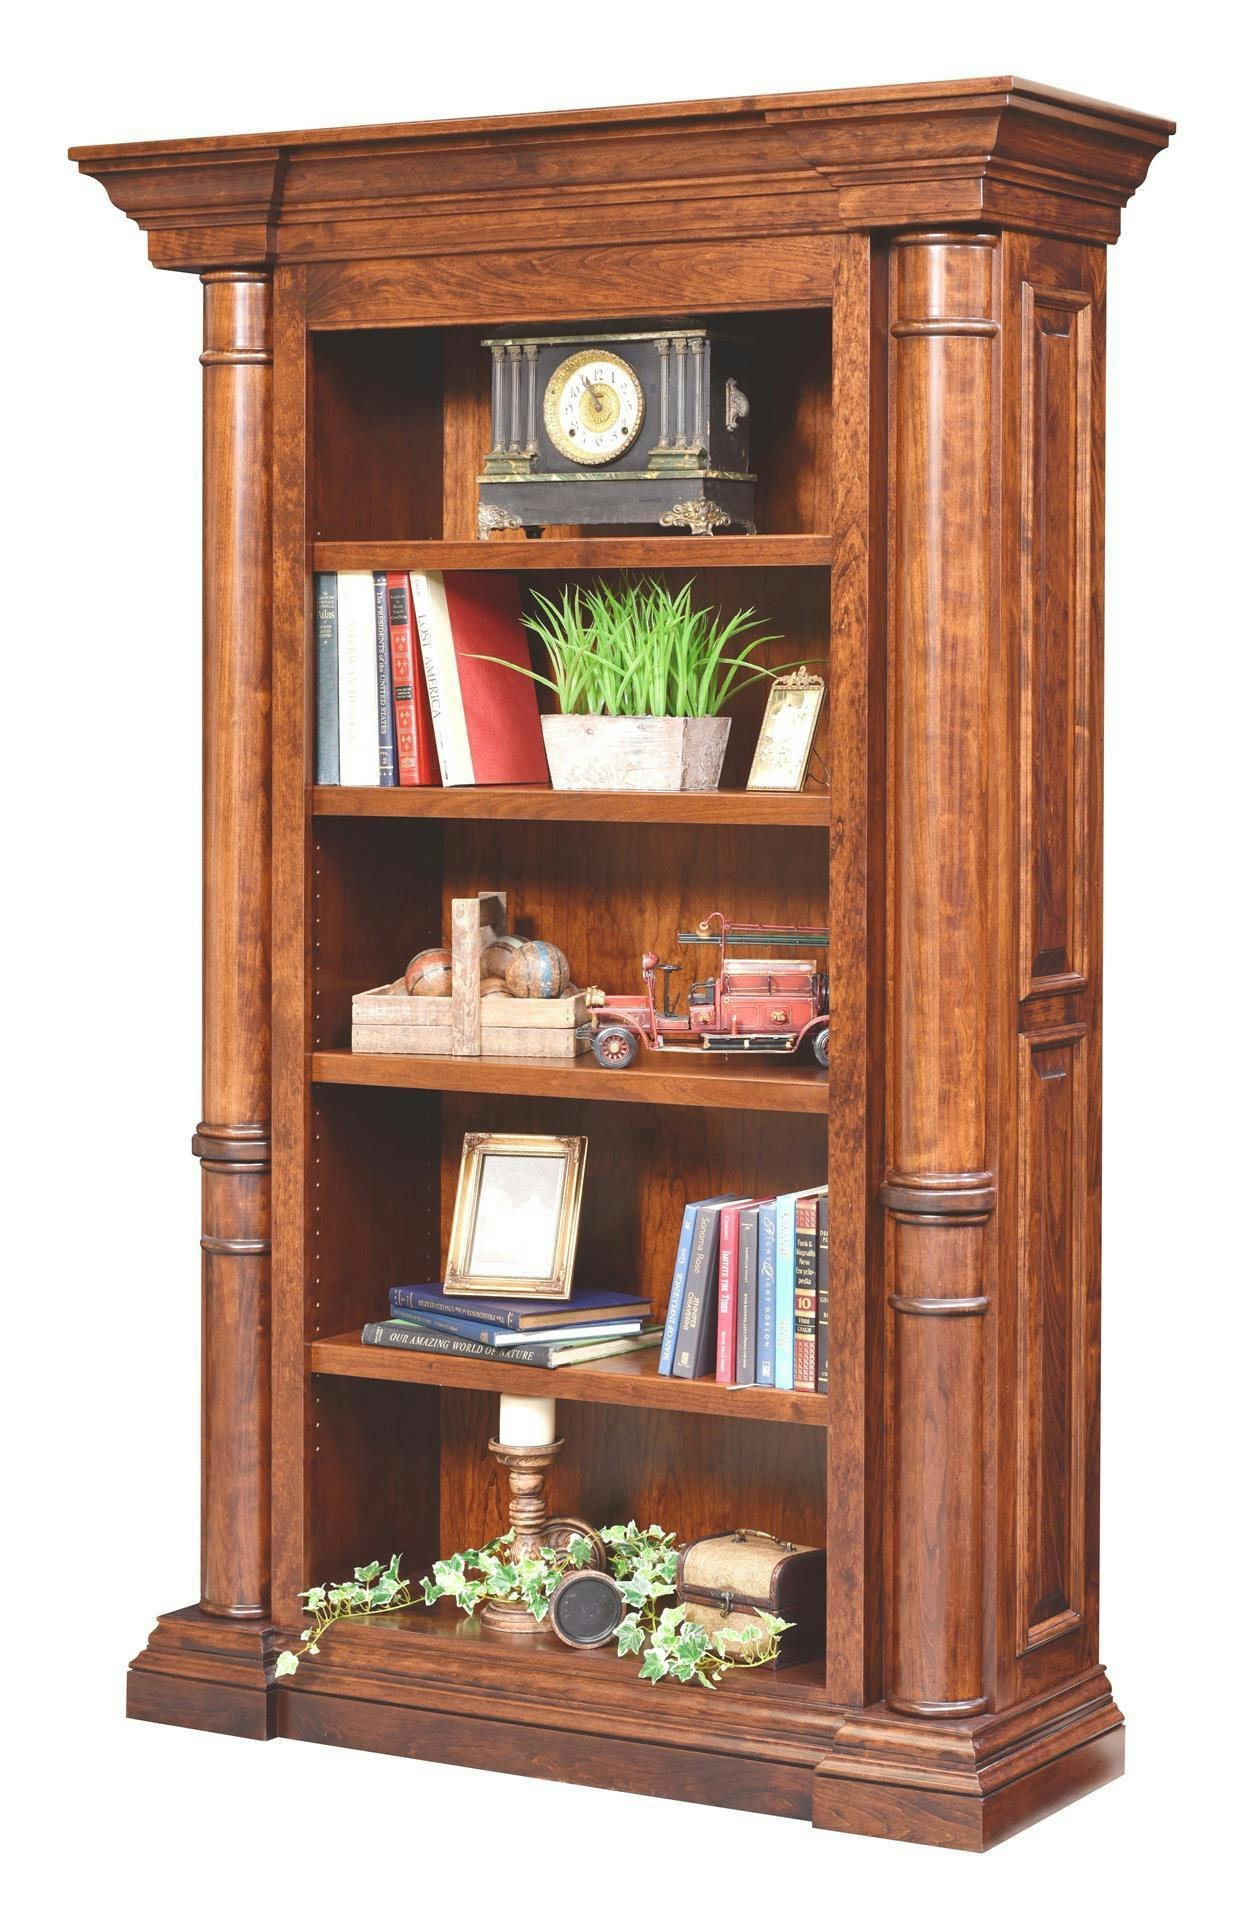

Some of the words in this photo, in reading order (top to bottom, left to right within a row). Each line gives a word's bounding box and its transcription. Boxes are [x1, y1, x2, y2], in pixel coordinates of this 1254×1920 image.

[594, 369, 604, 382] 12
[376, 591, 384, 604] The
[377, 605, 386, 654] PRESIDENTS
[417, 614, 432, 648] LOST
[380, 674, 388, 707] UNITED
[424, 656, 441, 719] AMERICA
[380, 706, 389, 735] STATES
[696, 1216, 710, 1251] Sonoma
[693, 1253, 705, 1274] Rose
[721, 1250, 732, 1278] IMITATE
[799, 1258, 811, 1266] New
[668, 1271, 683, 1323] INFLUENCE
[720, 1280, 728, 1292] THE
[467, 1309, 496, 1321] PRESIDENTS
[682, 1292, 694, 1331] CHIAVERINI
[690, 1295, 700, 1329] JENNIFER
[720, 1293, 731, 1314] TIGER
[798, 1297, 811, 1310] 10
[666, 1324, 675, 1337] OF
[763, 1306, 771, 1348] DOBSON
[388, 1332, 408, 1344] OUR
[409, 1335, 450, 1350] AMAZING
[452, 1340, 483, 1354] WORLD
[484, 1345, 497, 1356] OF
[498, 1347, 534, 1361] NATURE
[662, 1340, 672, 1361] MAN
